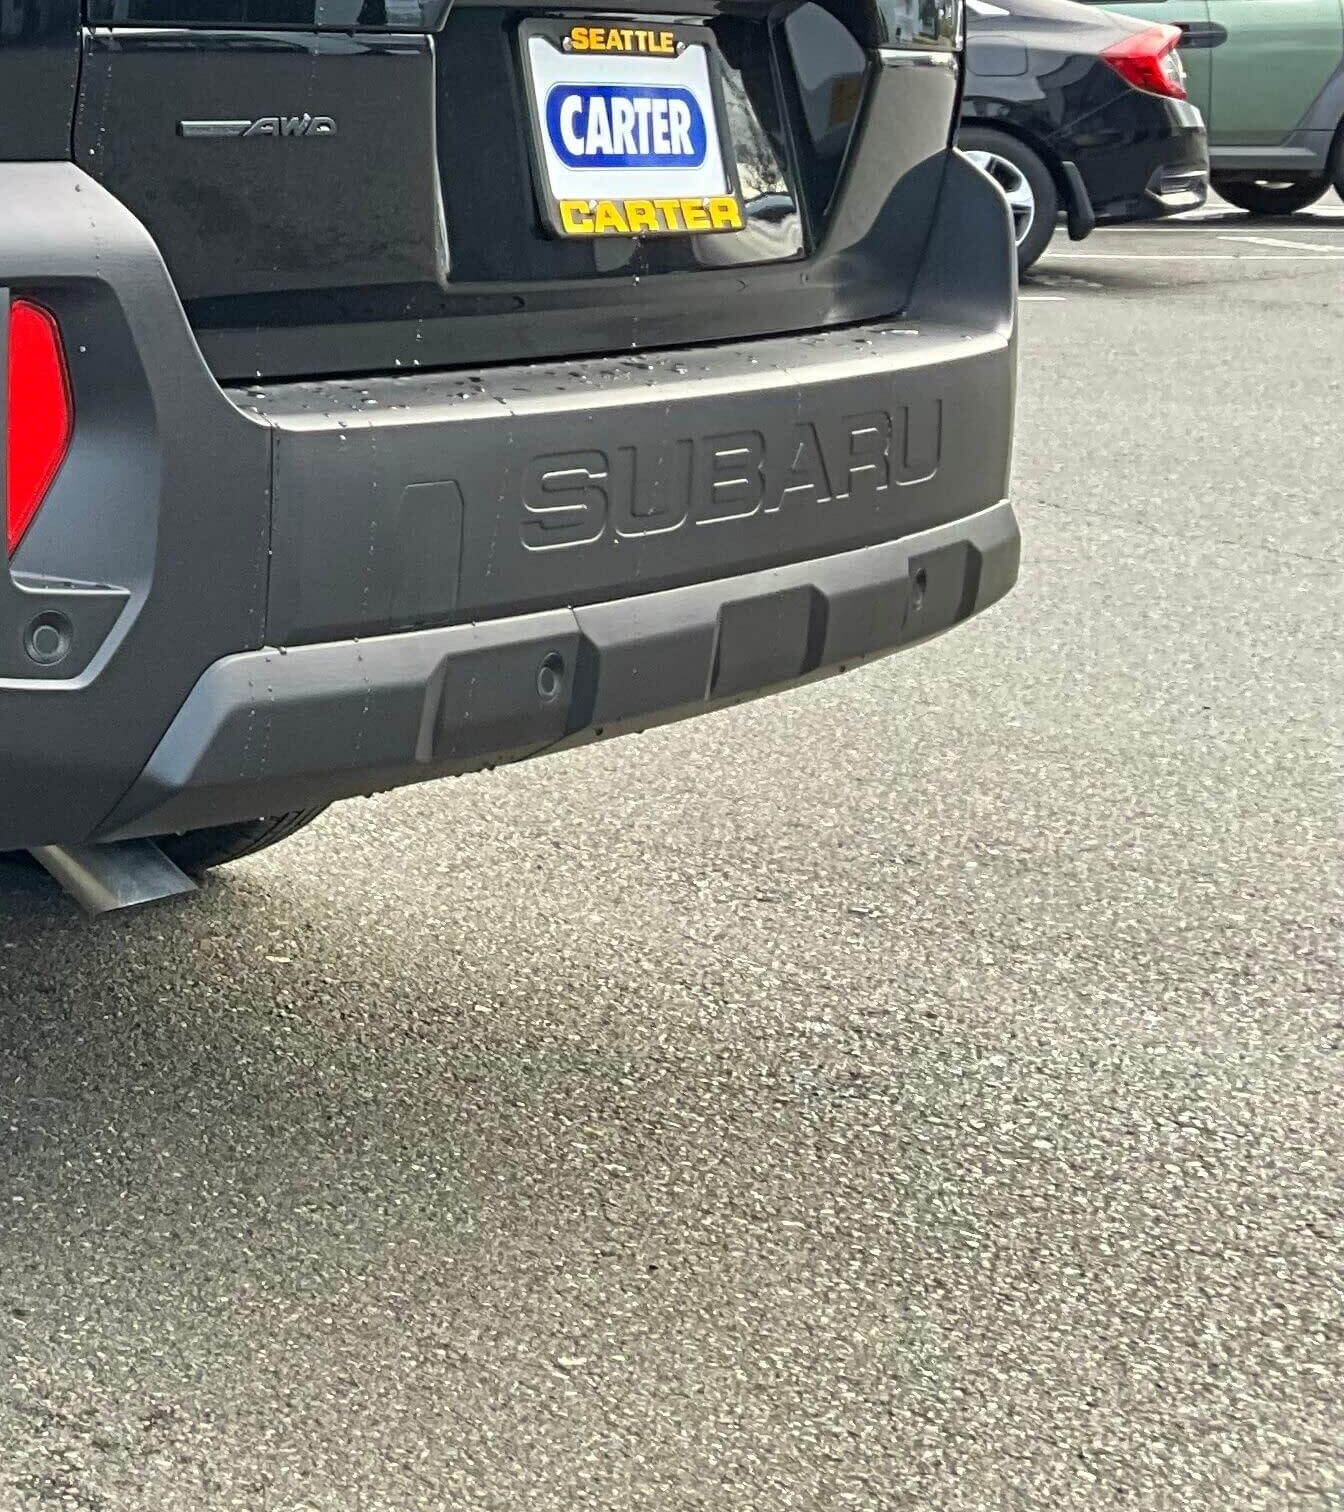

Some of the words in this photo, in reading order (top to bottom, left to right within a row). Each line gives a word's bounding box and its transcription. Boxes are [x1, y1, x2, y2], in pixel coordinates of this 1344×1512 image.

[570, 27, 675, 54] SEATTLE
[242, 113, 337, 137] AWD
[560, 94, 696, 156] CARTER
[560, 197, 743, 233] CARTER
[520, 400, 942, 551] SUBARU
